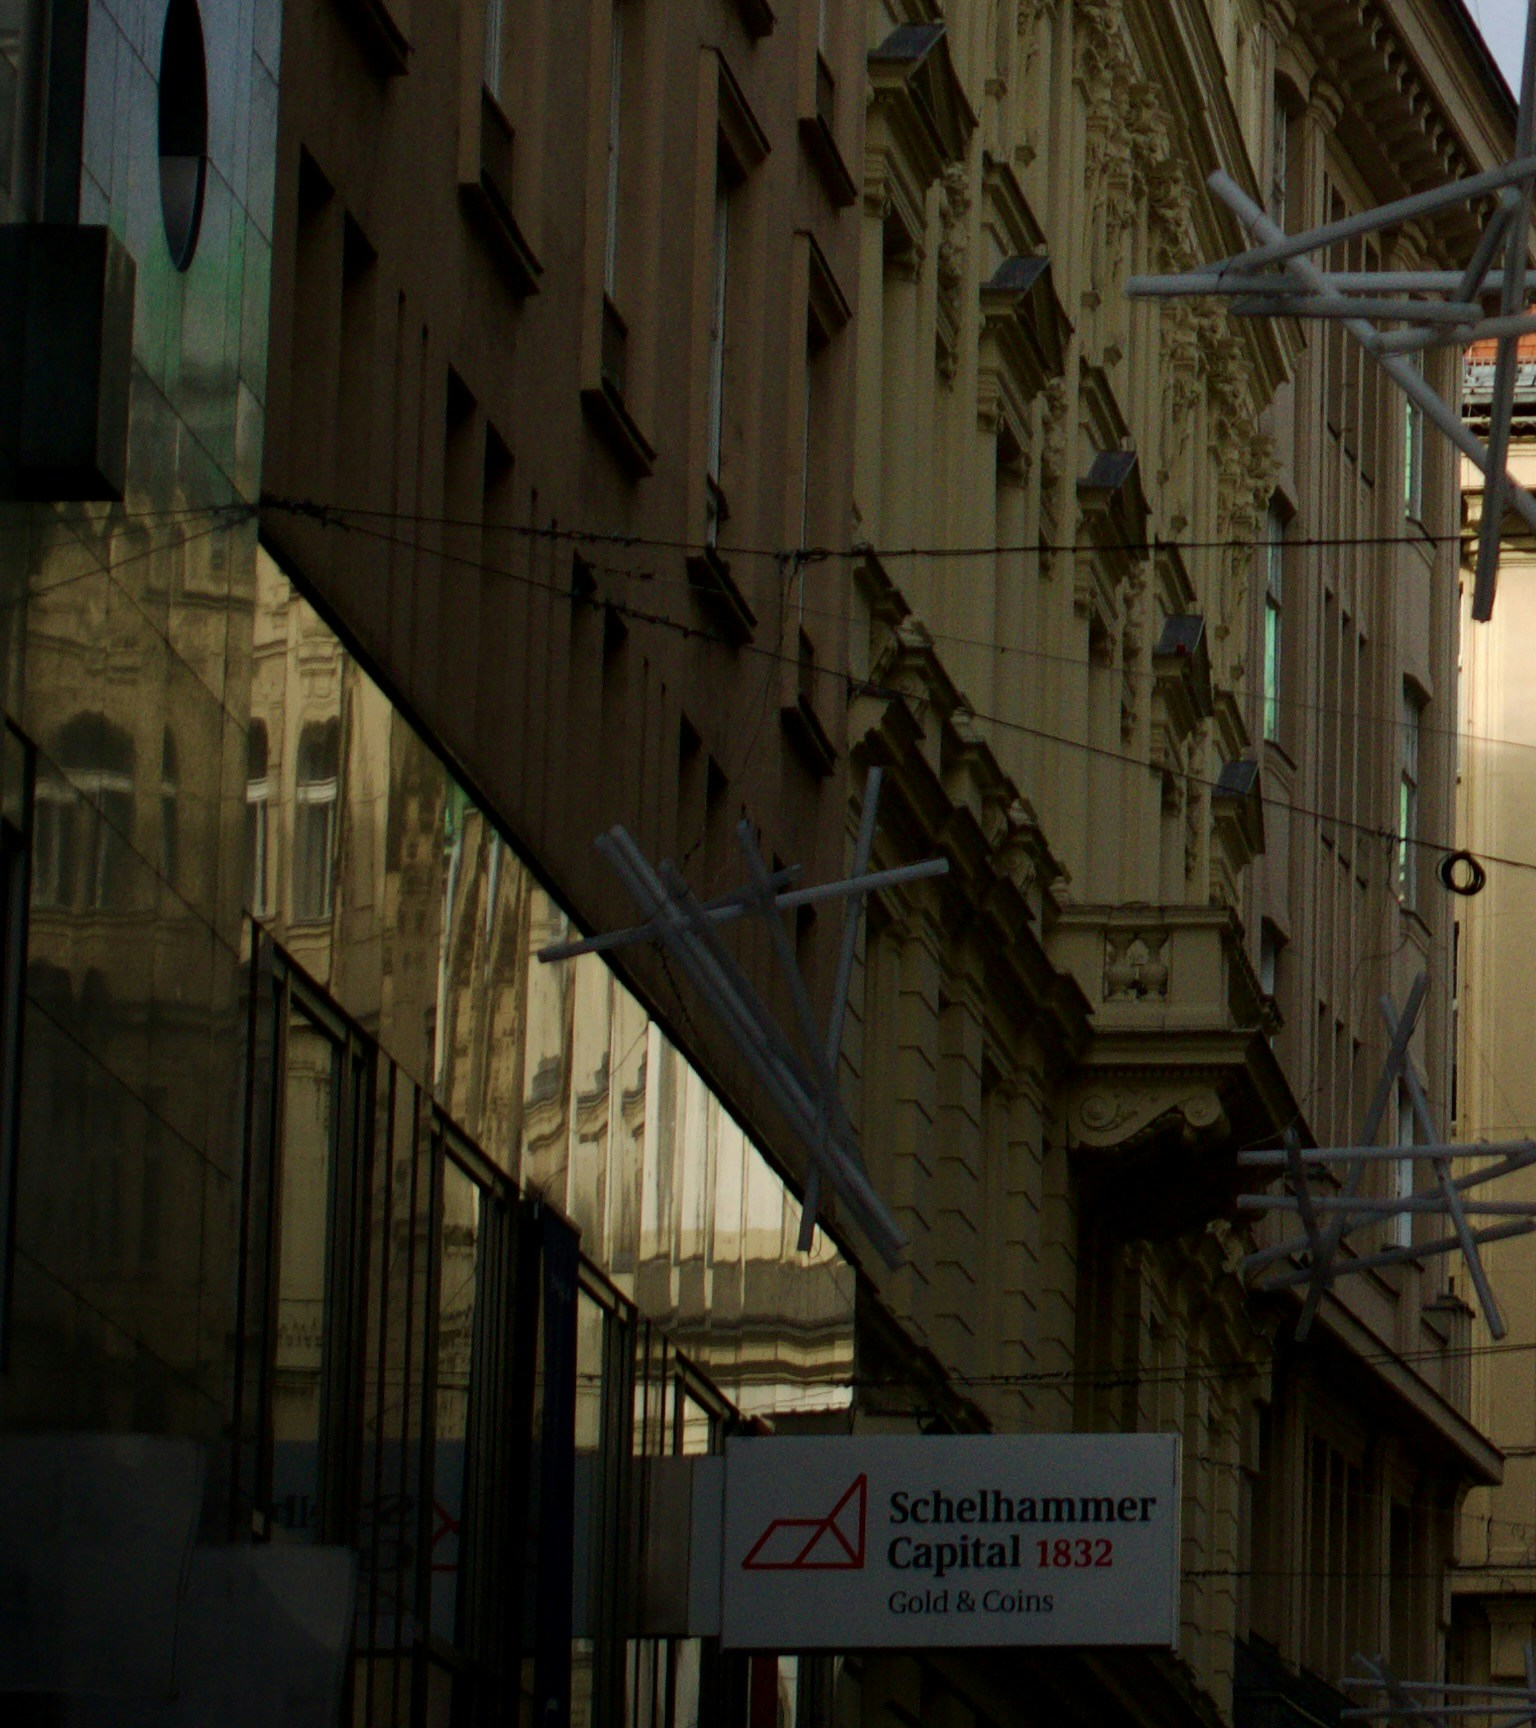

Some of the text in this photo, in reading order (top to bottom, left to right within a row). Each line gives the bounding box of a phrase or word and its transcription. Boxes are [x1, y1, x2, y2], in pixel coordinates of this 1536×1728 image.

[889, 1490, 1157, 1525] Schelhammer
[887, 1535, 1114, 1578] Capital 1832
[888, 1589, 1055, 1615] Gold & Coins
